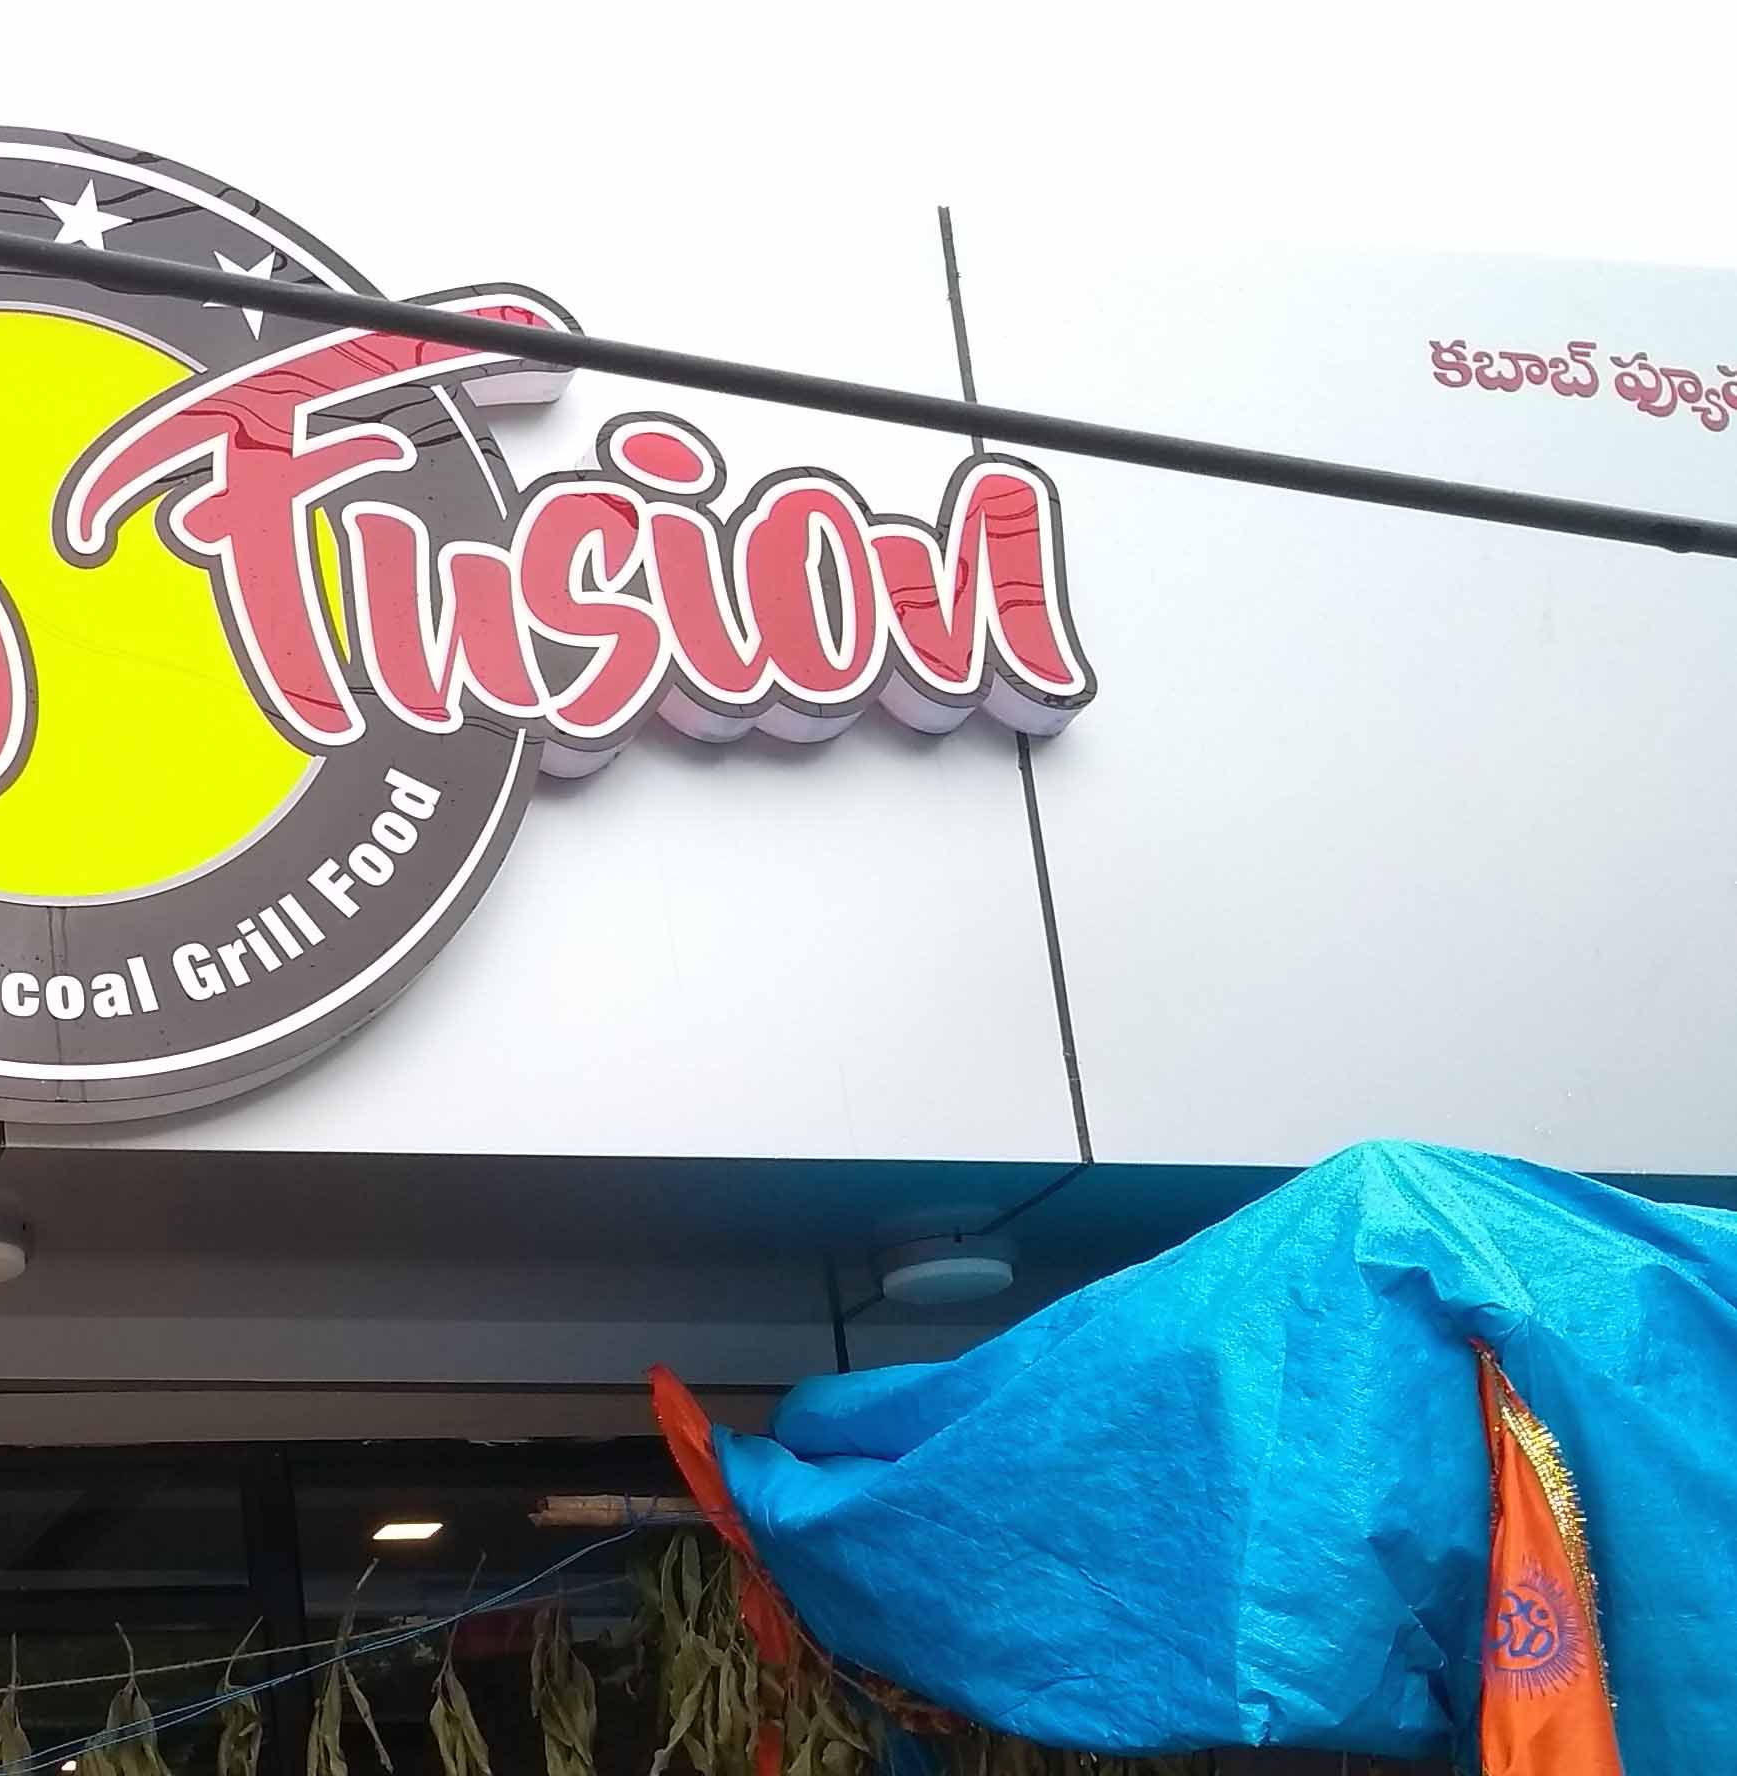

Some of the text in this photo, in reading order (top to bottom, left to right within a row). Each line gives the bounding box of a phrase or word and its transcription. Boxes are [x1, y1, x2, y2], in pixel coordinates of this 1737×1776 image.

[1427, 338, 1600, 399] కబాబ్
[60, 287, 1090, 747] Fusion
[170, 890, 327, 1002] Grill
[305, 766, 443, 920] Food
